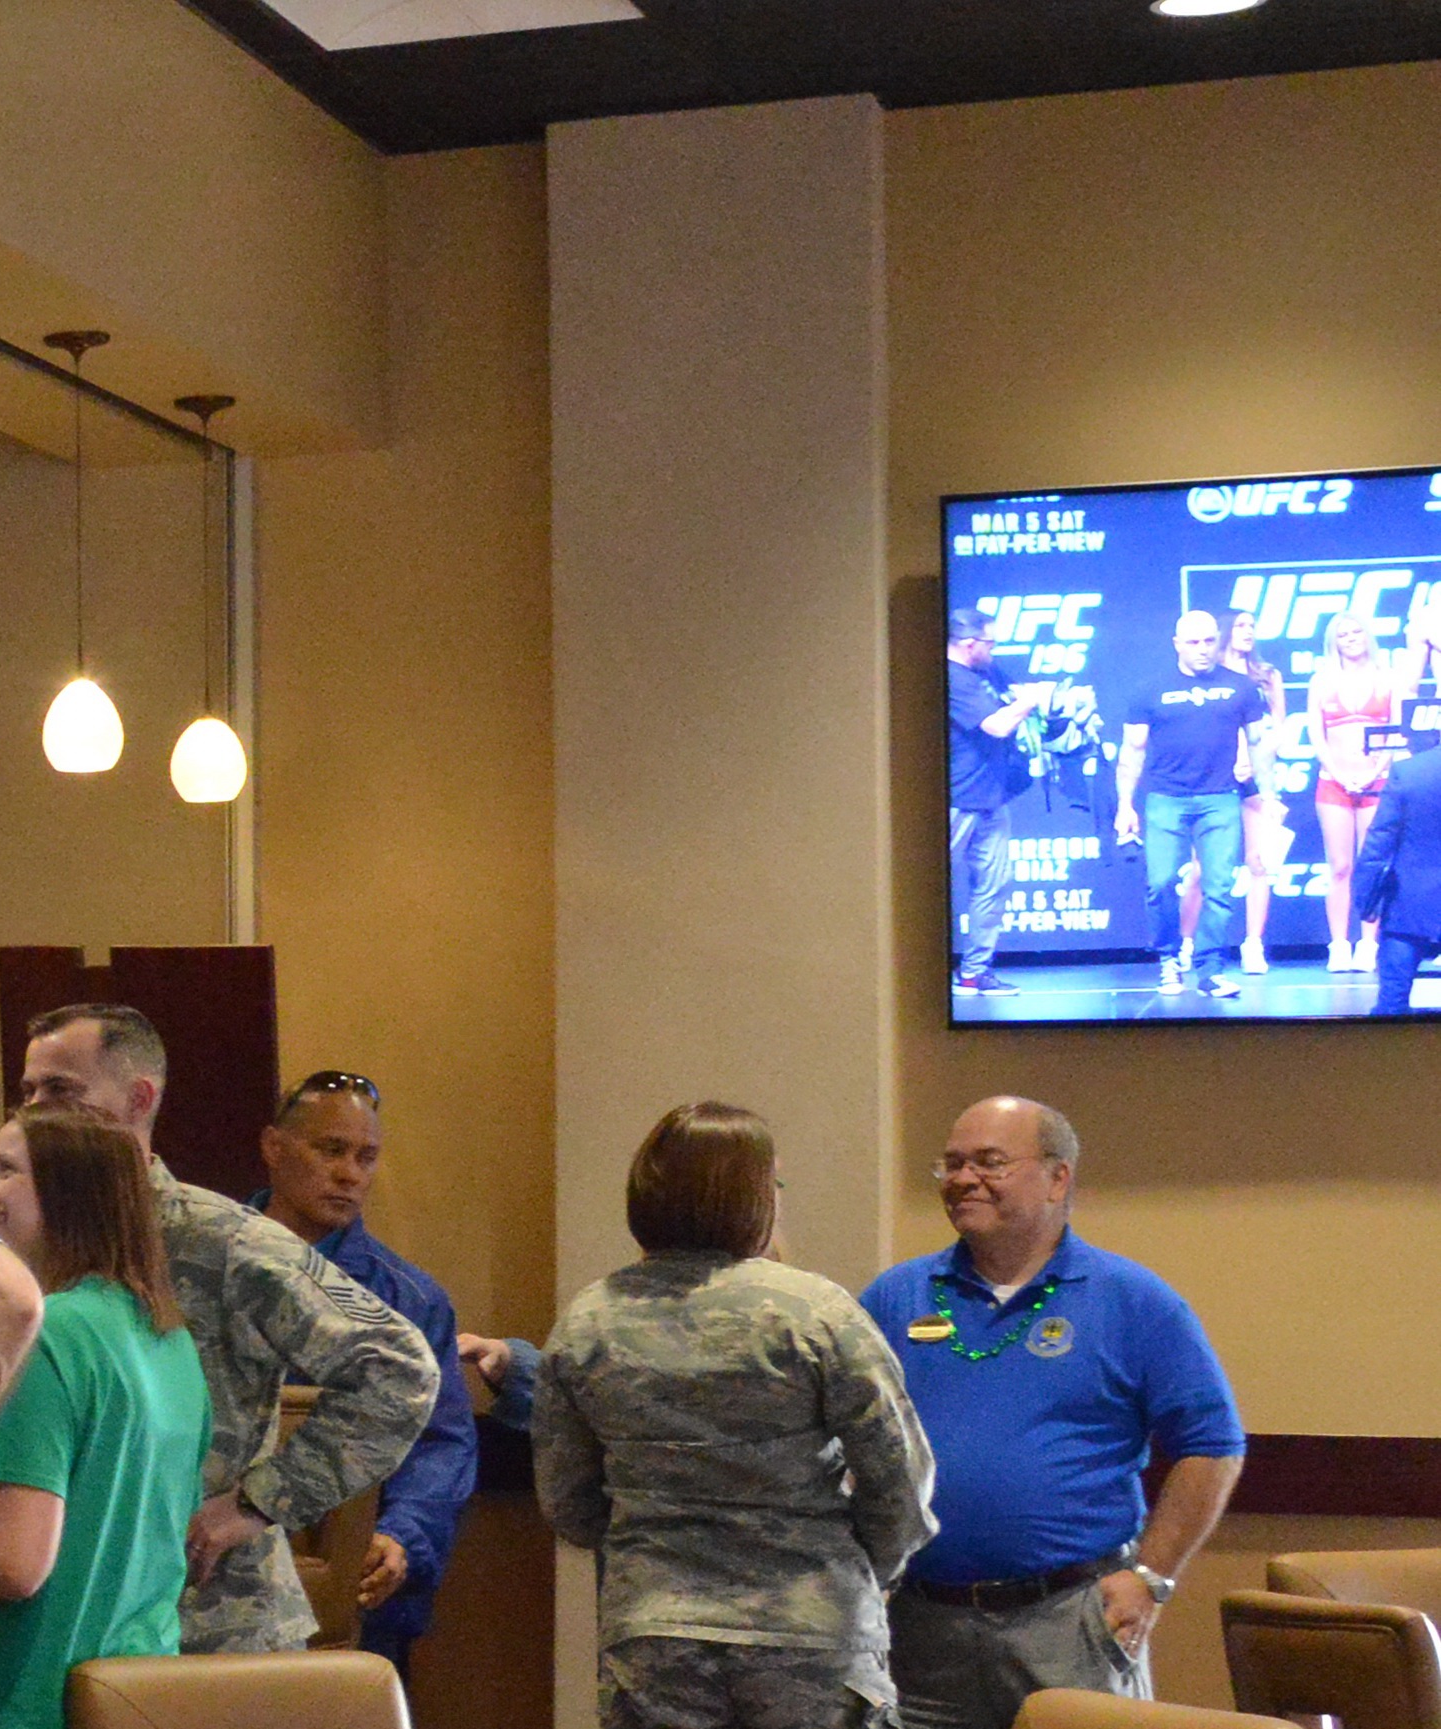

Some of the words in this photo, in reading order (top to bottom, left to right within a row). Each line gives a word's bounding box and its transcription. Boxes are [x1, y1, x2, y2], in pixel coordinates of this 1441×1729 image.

[1231, 481, 1322, 516] UFC
[1318, 479, 1353, 513] 2
[972, 512, 1019, 533] MAR
[1026, 512, 1040, 532] 5
[1047, 510, 1085, 531] SAT
[975, 531, 1105, 555] PAY-PER-VIEW
[1228, 569, 1414, 640] UFC
[976, 593, 1102, 642] UFC
[1028, 643, 1088, 674] 196
[1015, 859, 1069, 882] DIAZ
[1033, 890, 1047, 910] 5
[1053, 889, 1092, 910] SAT
[999, 909, 1110, 932] Y-PER-VIEW
